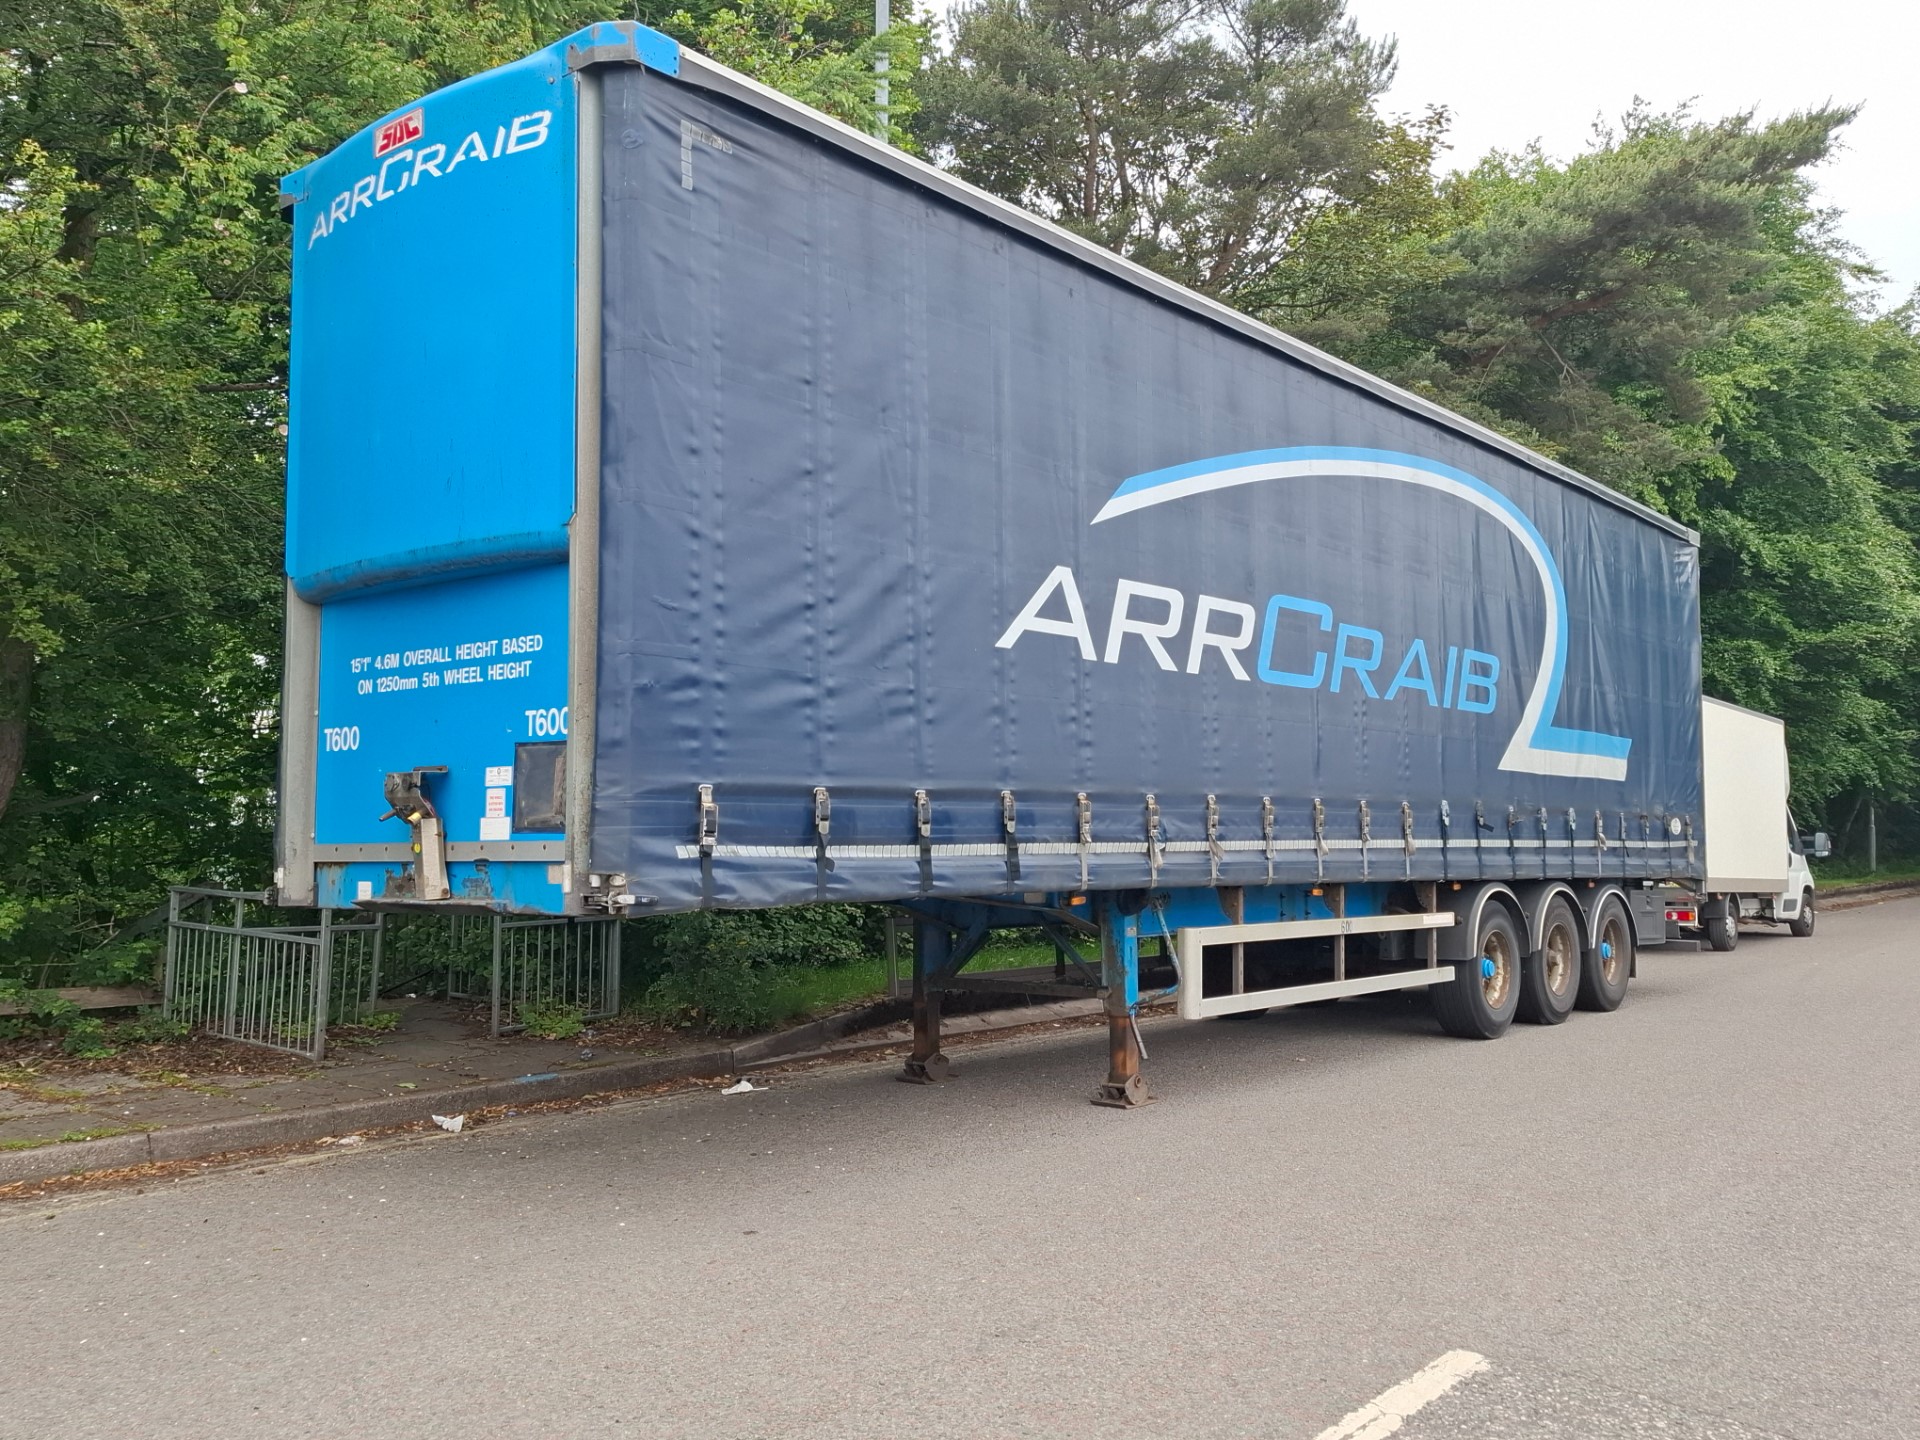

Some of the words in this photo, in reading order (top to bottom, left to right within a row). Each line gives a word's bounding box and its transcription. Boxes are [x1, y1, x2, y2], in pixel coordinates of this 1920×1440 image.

[378, 115, 420, 154] SDC
[307, 109, 553, 251] ARRCRAIB
[374, 653, 400, 670] 4.6M
[403, 646, 452, 667] OVERALL
[455, 640, 499, 661] HEIGHT
[502, 634, 543, 655] BASED
[995, 565, 1500, 714] ARRCRAIB
[357, 679, 373, 695] ON
[376, 675, 418, 693] 1250mm
[422, 671, 440, 688] 5th
[443, 666, 484, 686] WHEEL
[487, 660, 532, 681] HEIGHT
[324, 726, 360, 752] T600
